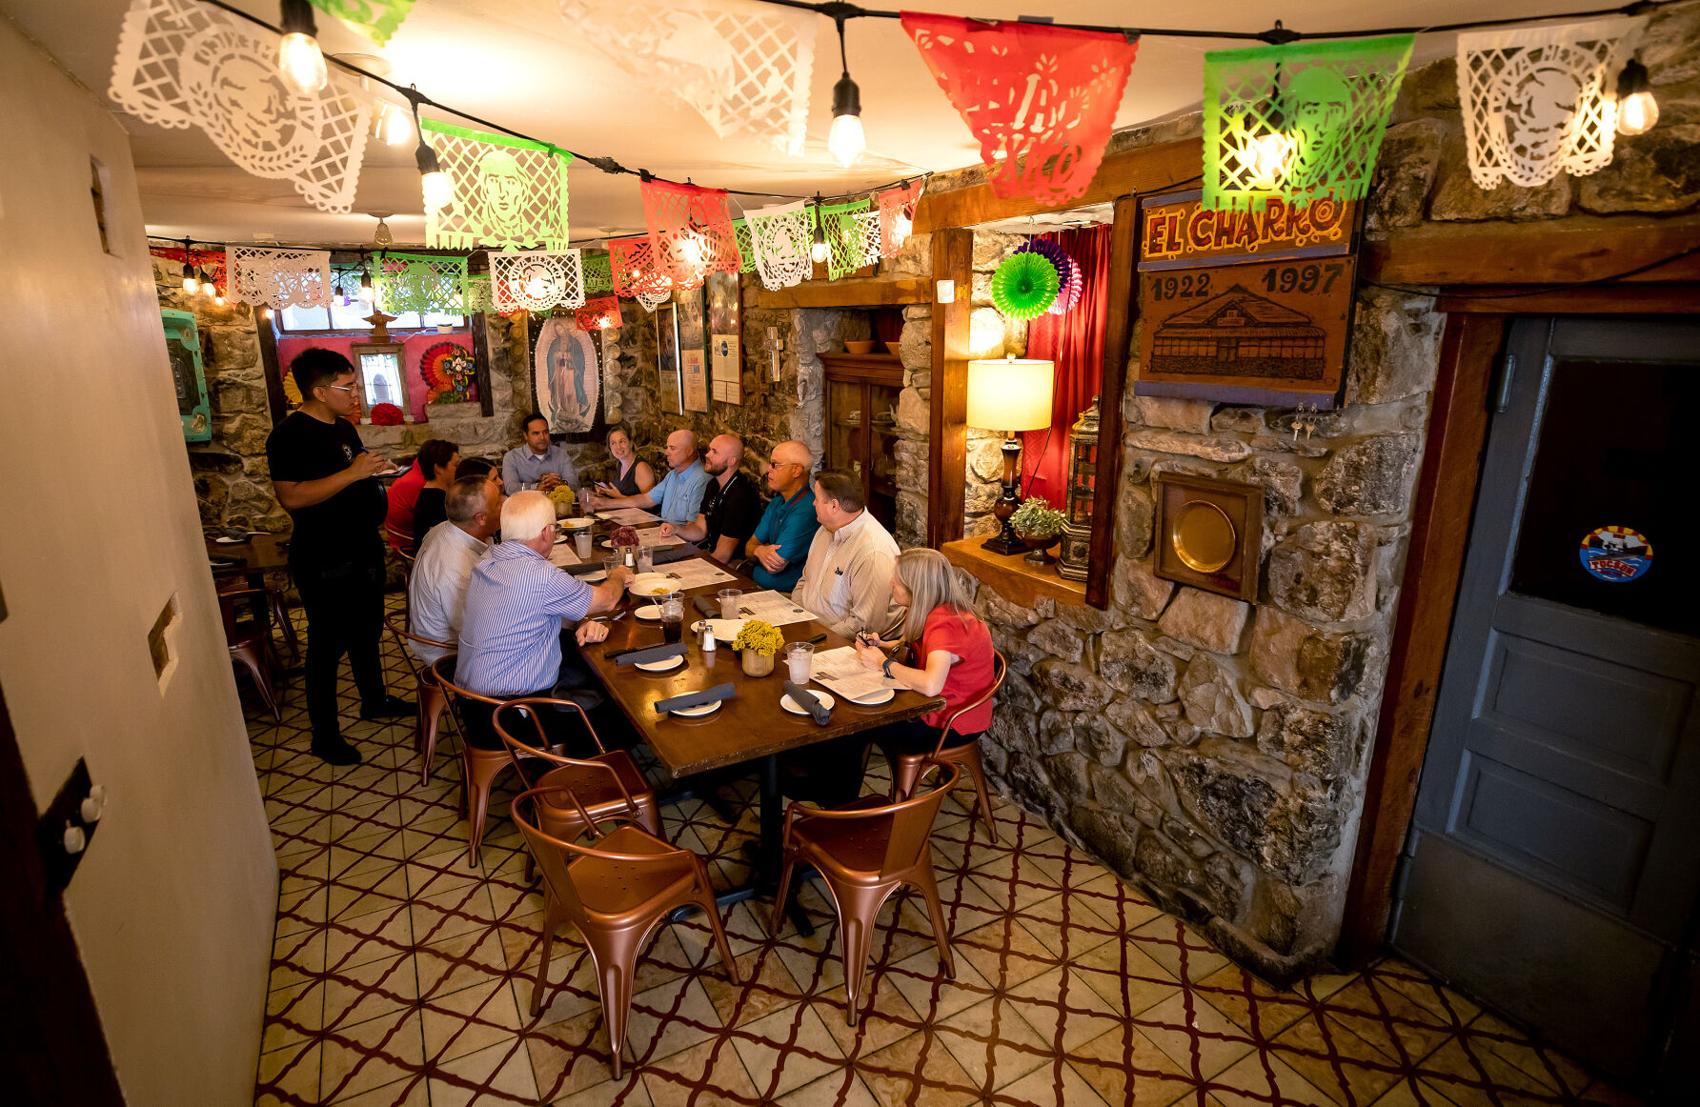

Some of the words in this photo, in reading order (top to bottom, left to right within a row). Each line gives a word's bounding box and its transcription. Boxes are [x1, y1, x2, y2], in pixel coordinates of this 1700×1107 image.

[1147, 212, 1184, 257] EL
[1187, 196, 1346, 249] CHARRO
[1151, 272, 1210, 301] 1922
[1261, 263, 1345, 294] 1997
